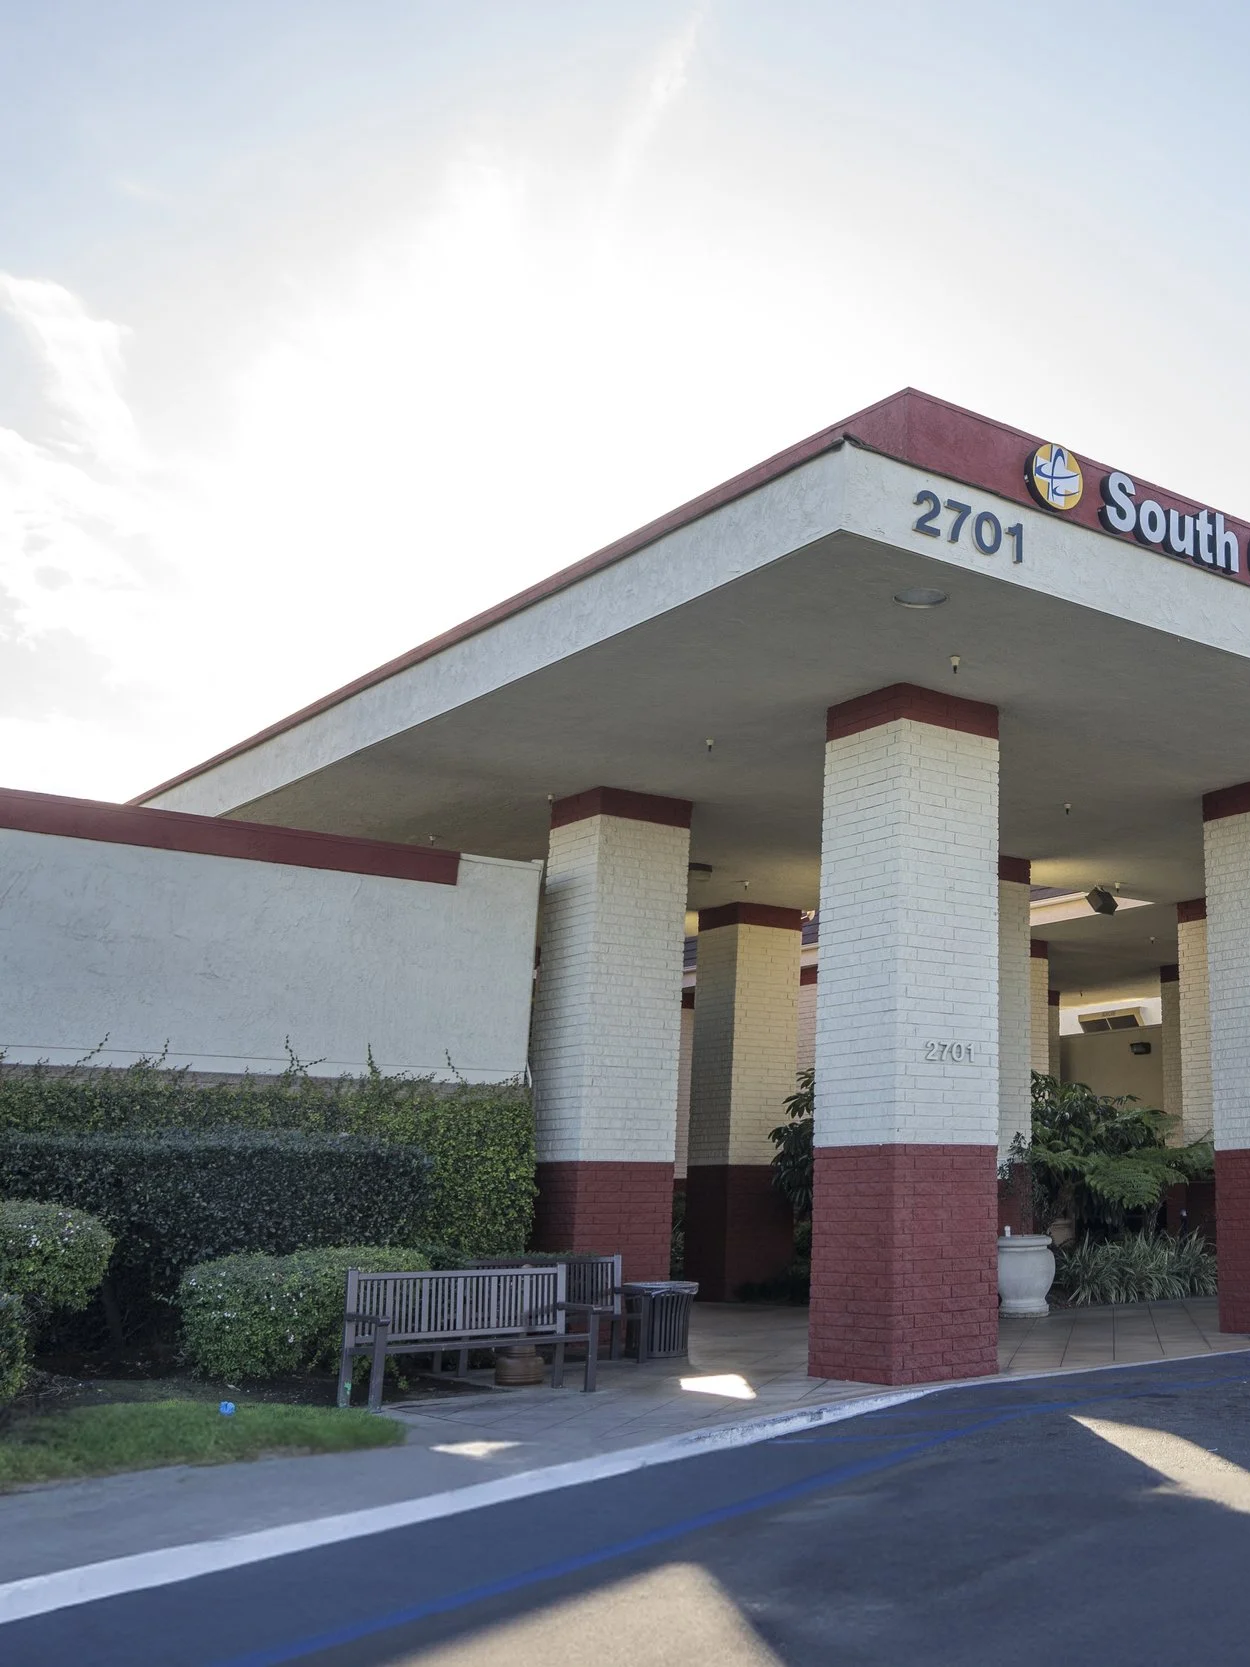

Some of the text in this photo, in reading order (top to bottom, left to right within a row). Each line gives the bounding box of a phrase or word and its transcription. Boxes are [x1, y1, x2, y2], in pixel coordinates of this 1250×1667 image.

[912, 489, 1024, 565] 2701
[1102, 471, 1239, 574] South
[925, 1040, 976, 1063] 2701
